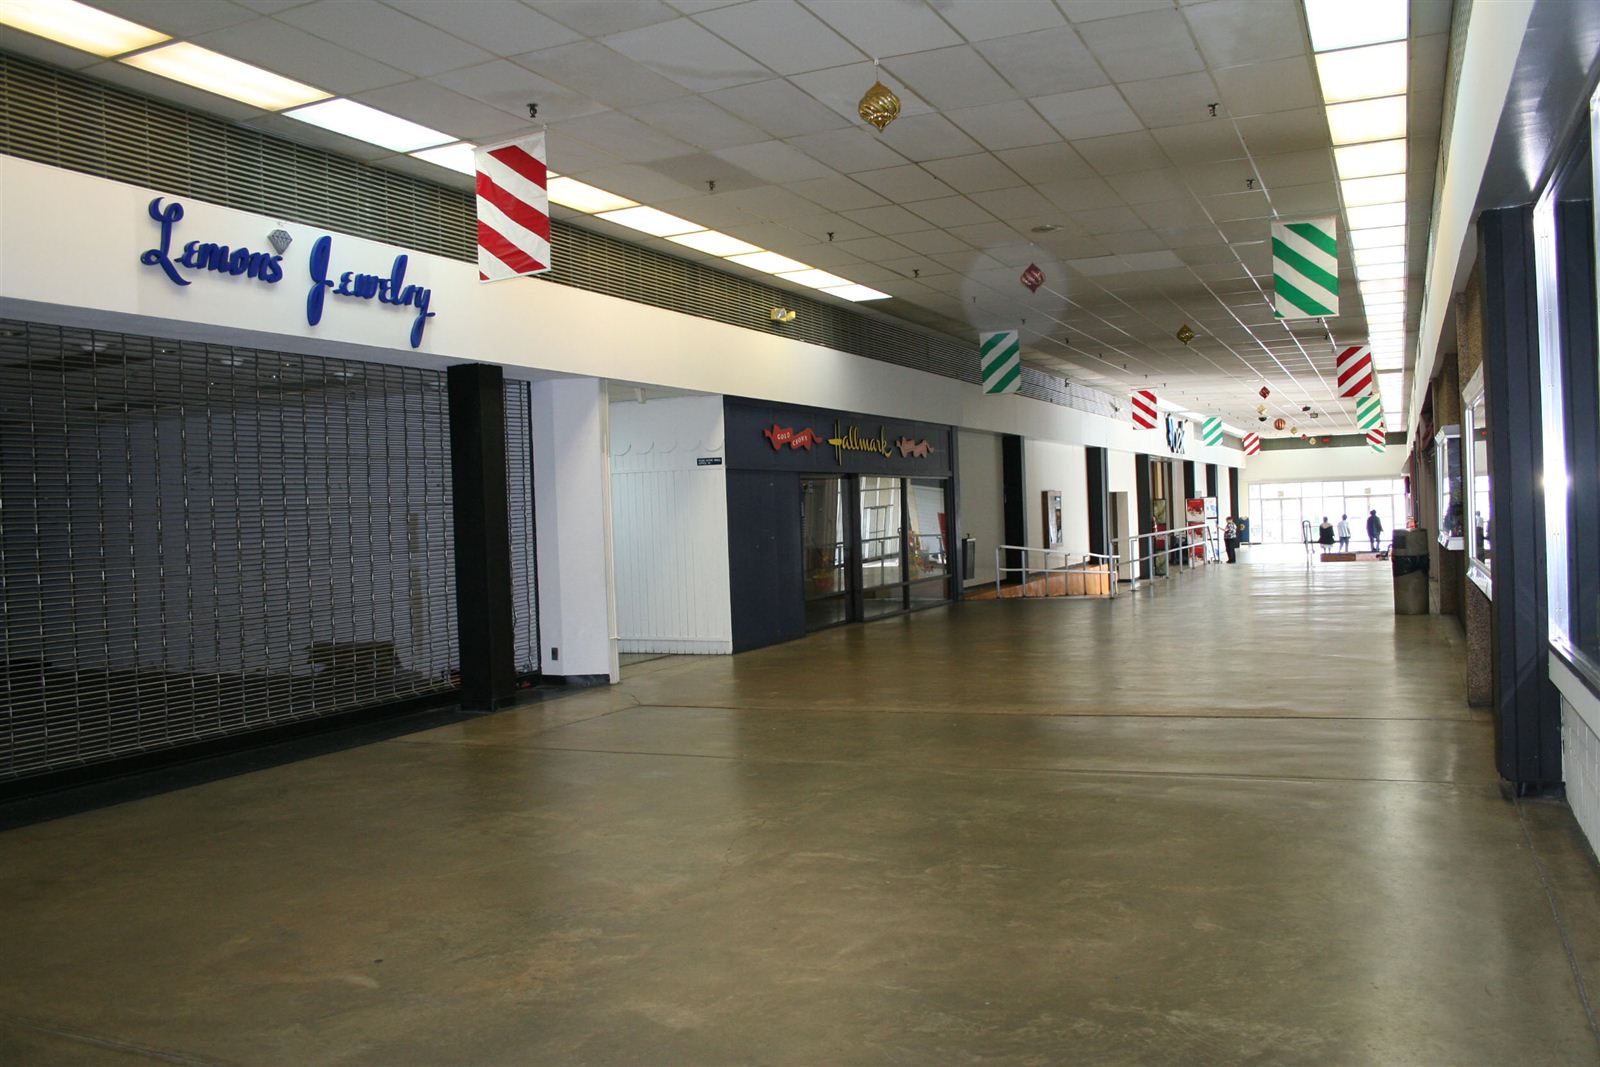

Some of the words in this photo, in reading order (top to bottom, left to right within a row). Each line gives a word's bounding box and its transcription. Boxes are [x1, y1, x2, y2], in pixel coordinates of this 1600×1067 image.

[141, 197, 283, 286] Lemons
[307, 235, 436, 348] Jewelry
[828, 419, 893, 466] Hallmark
